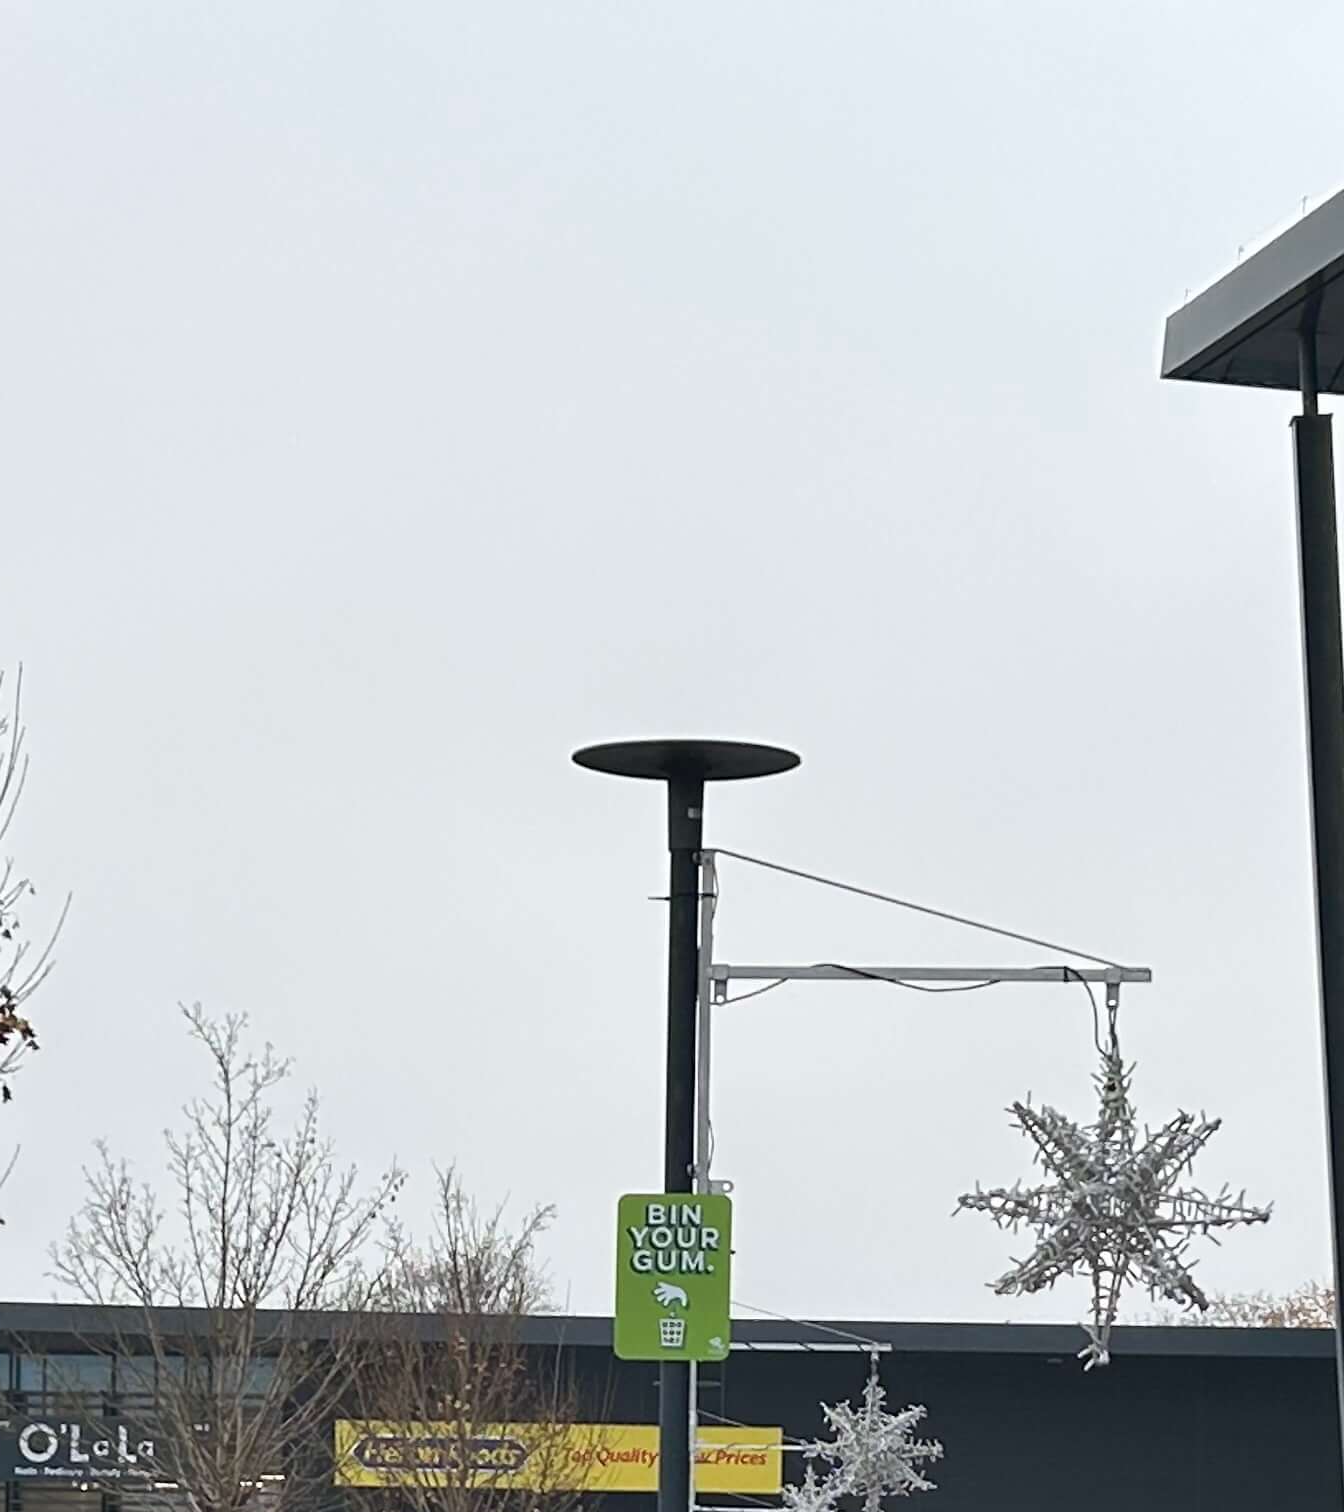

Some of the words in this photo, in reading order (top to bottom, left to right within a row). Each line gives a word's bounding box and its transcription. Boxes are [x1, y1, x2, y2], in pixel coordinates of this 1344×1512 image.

[646, 1203, 701, 1225] BIN
[628, 1226, 720, 1250] YOUR
[631, 1250, 715, 1273] GUM.
[596, 1447, 659, 1468] Quality
[715, 1449, 767, 1466] Prices
